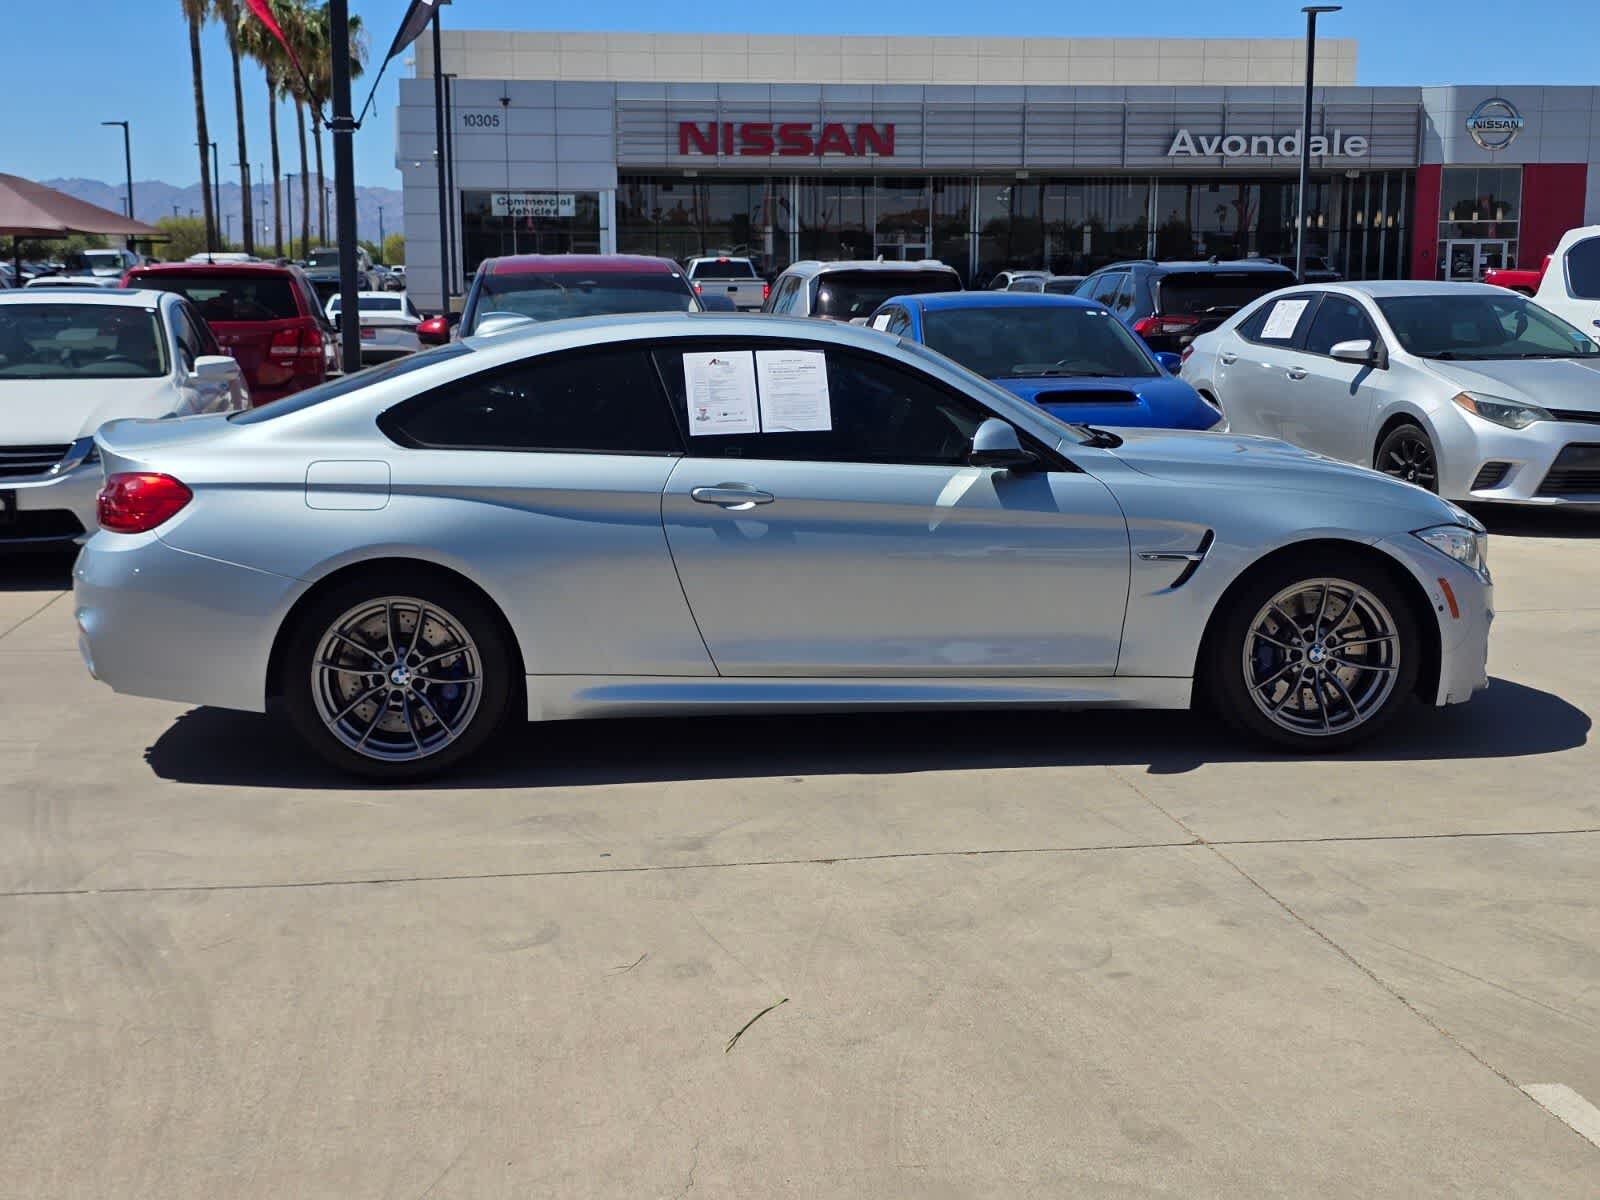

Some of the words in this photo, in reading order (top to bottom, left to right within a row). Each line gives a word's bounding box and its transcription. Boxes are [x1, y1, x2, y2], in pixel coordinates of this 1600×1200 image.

[463, 114, 500, 128] 10305
[1473, 120, 1519, 129] NISSAN
[679, 121, 895, 157] NISSAN
[1167, 129, 1369, 157] Avondale
[497, 196, 571, 206] Commercal
